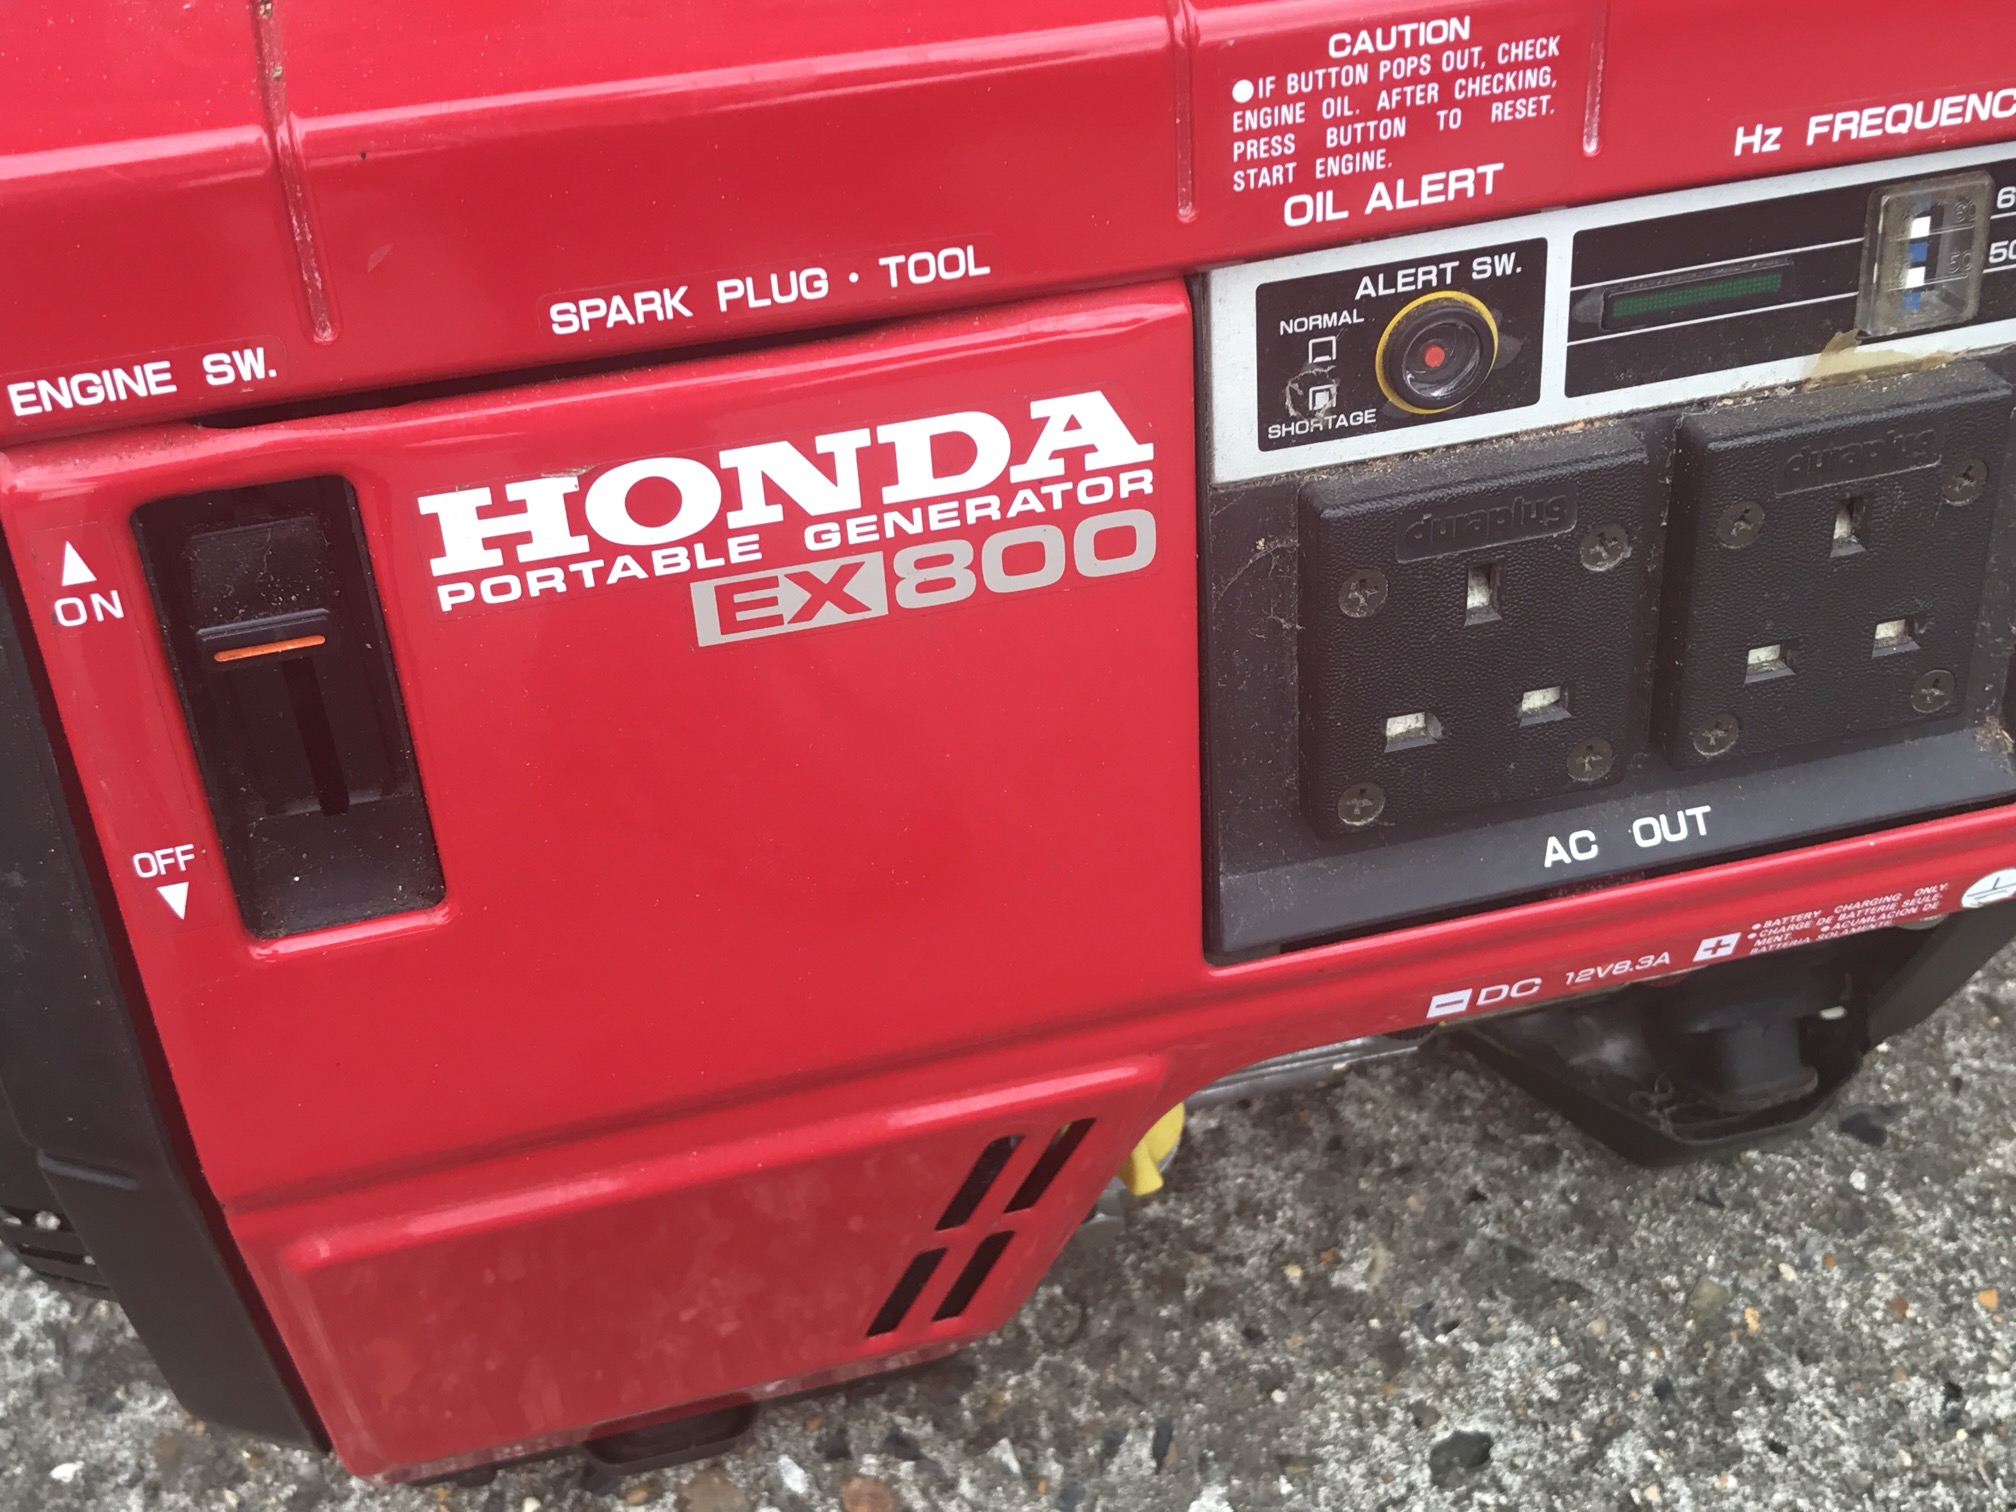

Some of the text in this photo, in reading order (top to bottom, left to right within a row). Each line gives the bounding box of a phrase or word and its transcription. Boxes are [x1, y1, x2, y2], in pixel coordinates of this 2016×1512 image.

[1329, 16, 1471, 58] CAUTION
[1258, 35, 1561, 99] IF BUTTON POPS OUT, CHECK
[1233, 65, 1557, 133] ENGINE OIL. AFTER CHECKING,
[1233, 95, 1555, 162] PRESS BUTTON TO RESET.
[1734, 123, 1782, 156] Hz
[1233, 149, 1393, 192] START ENGINE.
[1283, 162, 1504, 227] OIL ALERT
[1996, 186, 2016, 209] 6
[549, 245, 991, 336] SPARK PLUG TOOL
[1354, 251, 1522, 301] ALERT SW.
[1280, 309, 1365, 336] NORMAL
[7, 347, 278, 416] ENGINE SW.
[1267, 408, 1377, 440] SHORTAGE
[417, 389, 1156, 577] HONDA
[437, 468, 1155, 613] PORTABLE GENERATOR
[1404, 494, 1567, 546] duraplug
[700, 508, 1158, 642] EX800
[54, 589, 125, 628] ON
[132, 843, 196, 879] OFF
[1543, 805, 1712, 868] AC OUT
[1758, 921, 1812, 938] CHARGE
[1816, 916, 1834, 927] DE
[1838, 903, 1898, 922] BATTERIE
[1763, 910, 1822, 929] BATTERY
[1833, 893, 1902, 914] CHARGING
[1922, 901, 1940, 912] DE
[1475, 951, 1671, 1006] DC 12V8.3A
